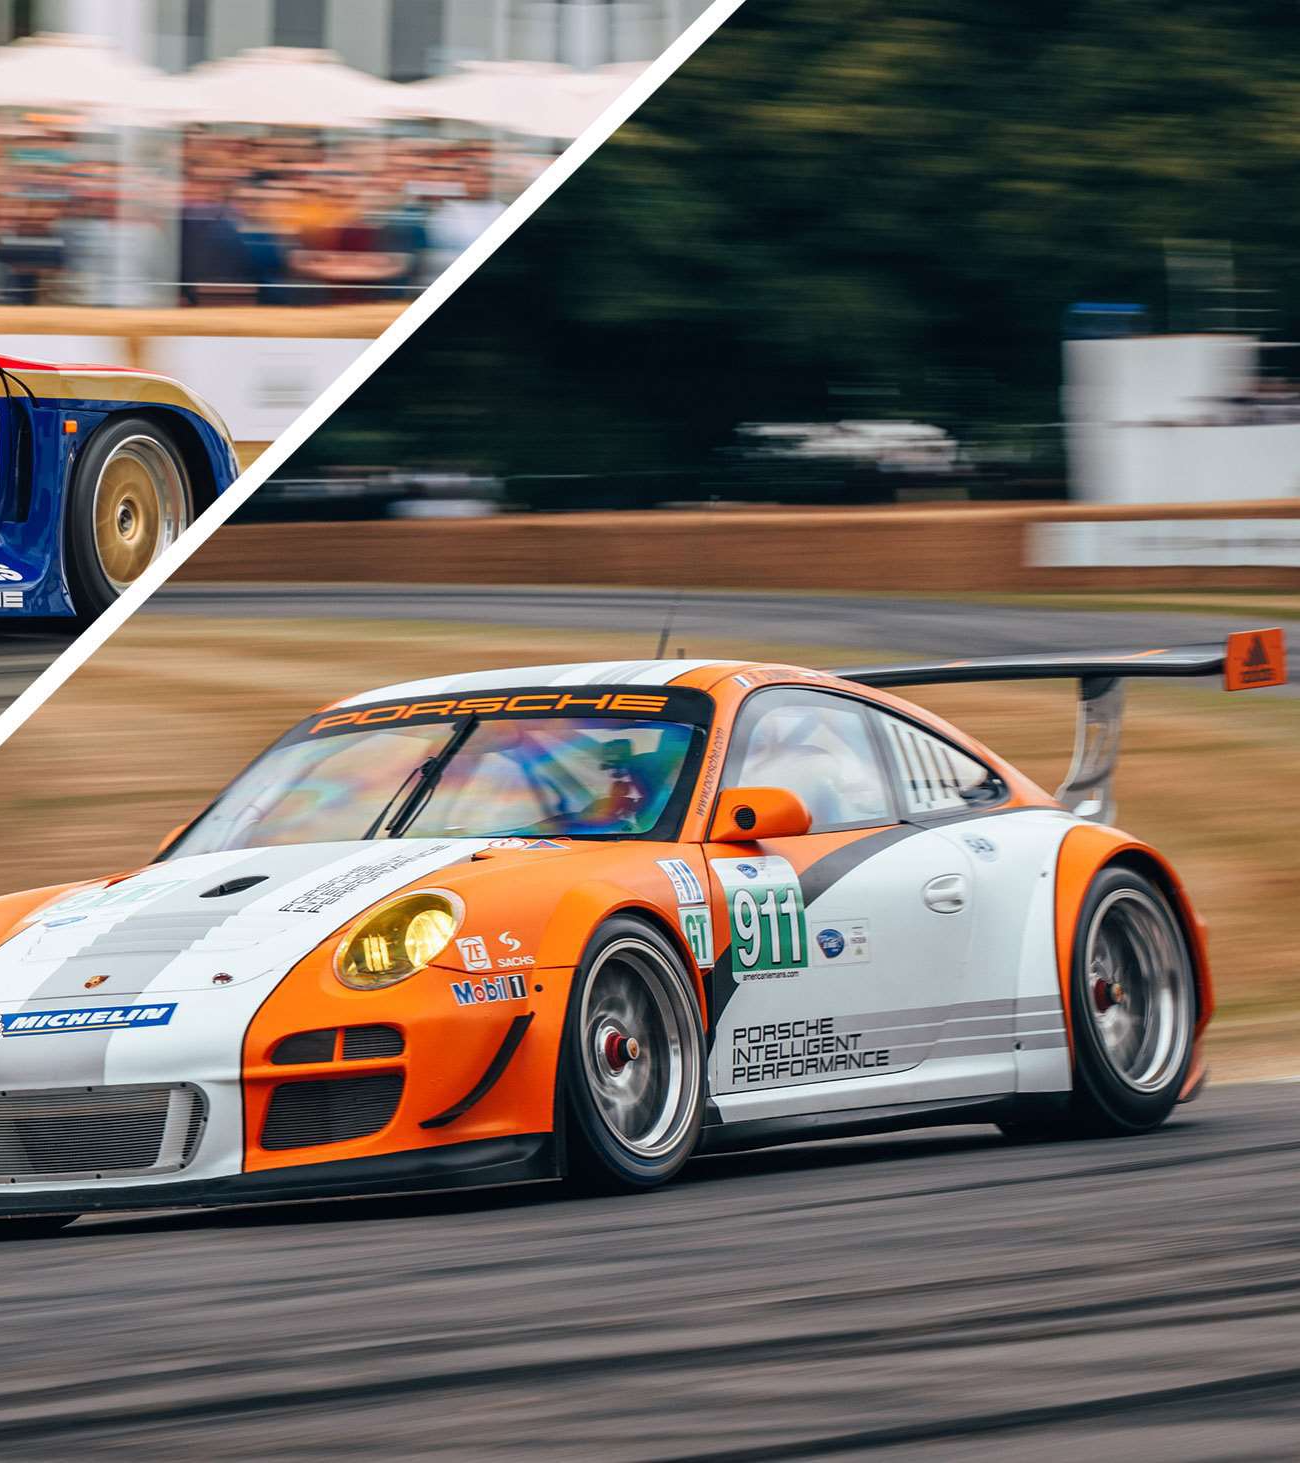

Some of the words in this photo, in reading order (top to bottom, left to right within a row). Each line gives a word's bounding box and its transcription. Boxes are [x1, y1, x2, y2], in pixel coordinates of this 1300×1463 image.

[308, 694, 669, 734] PORSCHE
[695, 727, 725, 817] www.porsche.com
[685, 914, 708, 960] GT
[733, 887, 801, 968] 911
[461, 943, 488, 963] ZF
[497, 955, 537, 968] SACHS
[451, 976, 509, 1005] Mobil
[510, 976, 523, 997] 1
[7, 1007, 170, 1031] MICHELIN
[733, 1017, 834, 1046] PORSCHE
[733, 1034, 862, 1066] INTELLIGENT
[732, 1050, 890, 1085] PERFORMANCE
